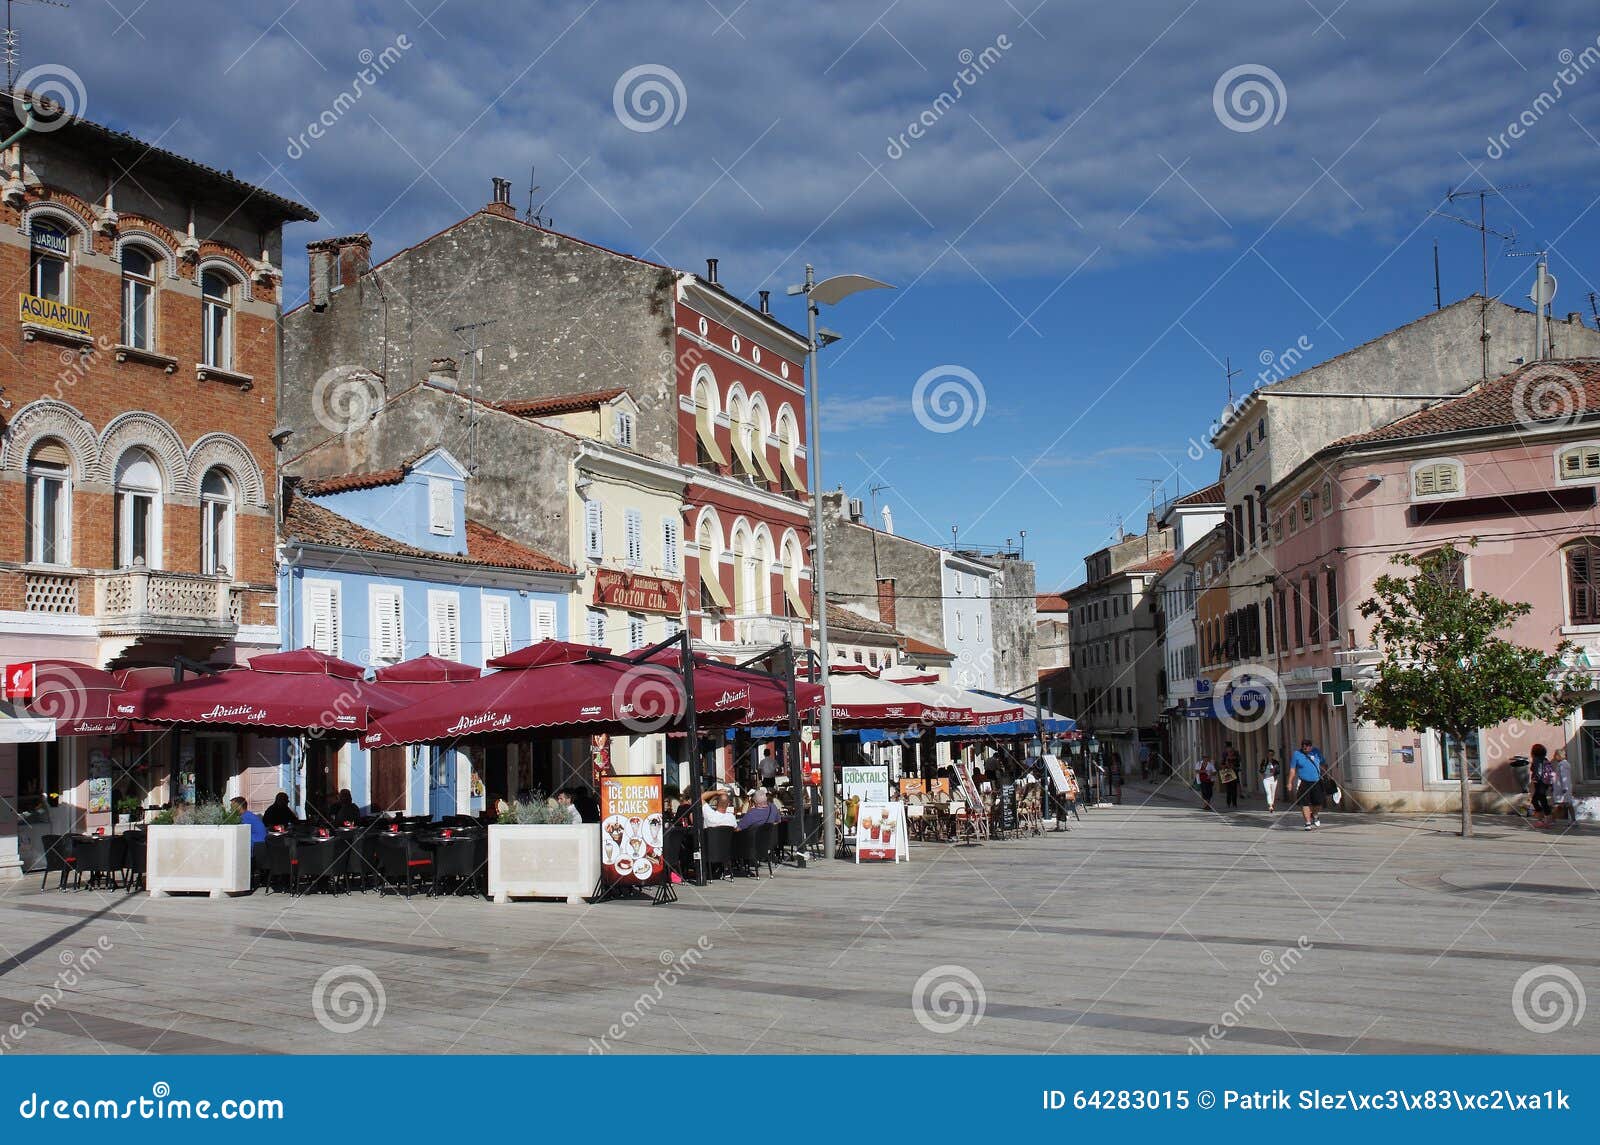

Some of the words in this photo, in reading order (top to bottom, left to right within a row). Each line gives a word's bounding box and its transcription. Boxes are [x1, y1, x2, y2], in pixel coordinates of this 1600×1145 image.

[34, 233, 67, 251] UARIUM
[21, 296, 91, 329] AQUARIUM
[613, 587, 645, 606] COTTON
[201, 704, 252, 719] Adriatic
[816, 708, 850, 717] CTRAL
[446, 711, 497, 733] Adriatic
[844, 771, 887, 784] COCKTAILS
[608, 786, 623, 800] ICE
[625, 785, 659, 800] CREAM
[608, 801, 616, 814] &
[617, 801, 649, 814] CAKES
